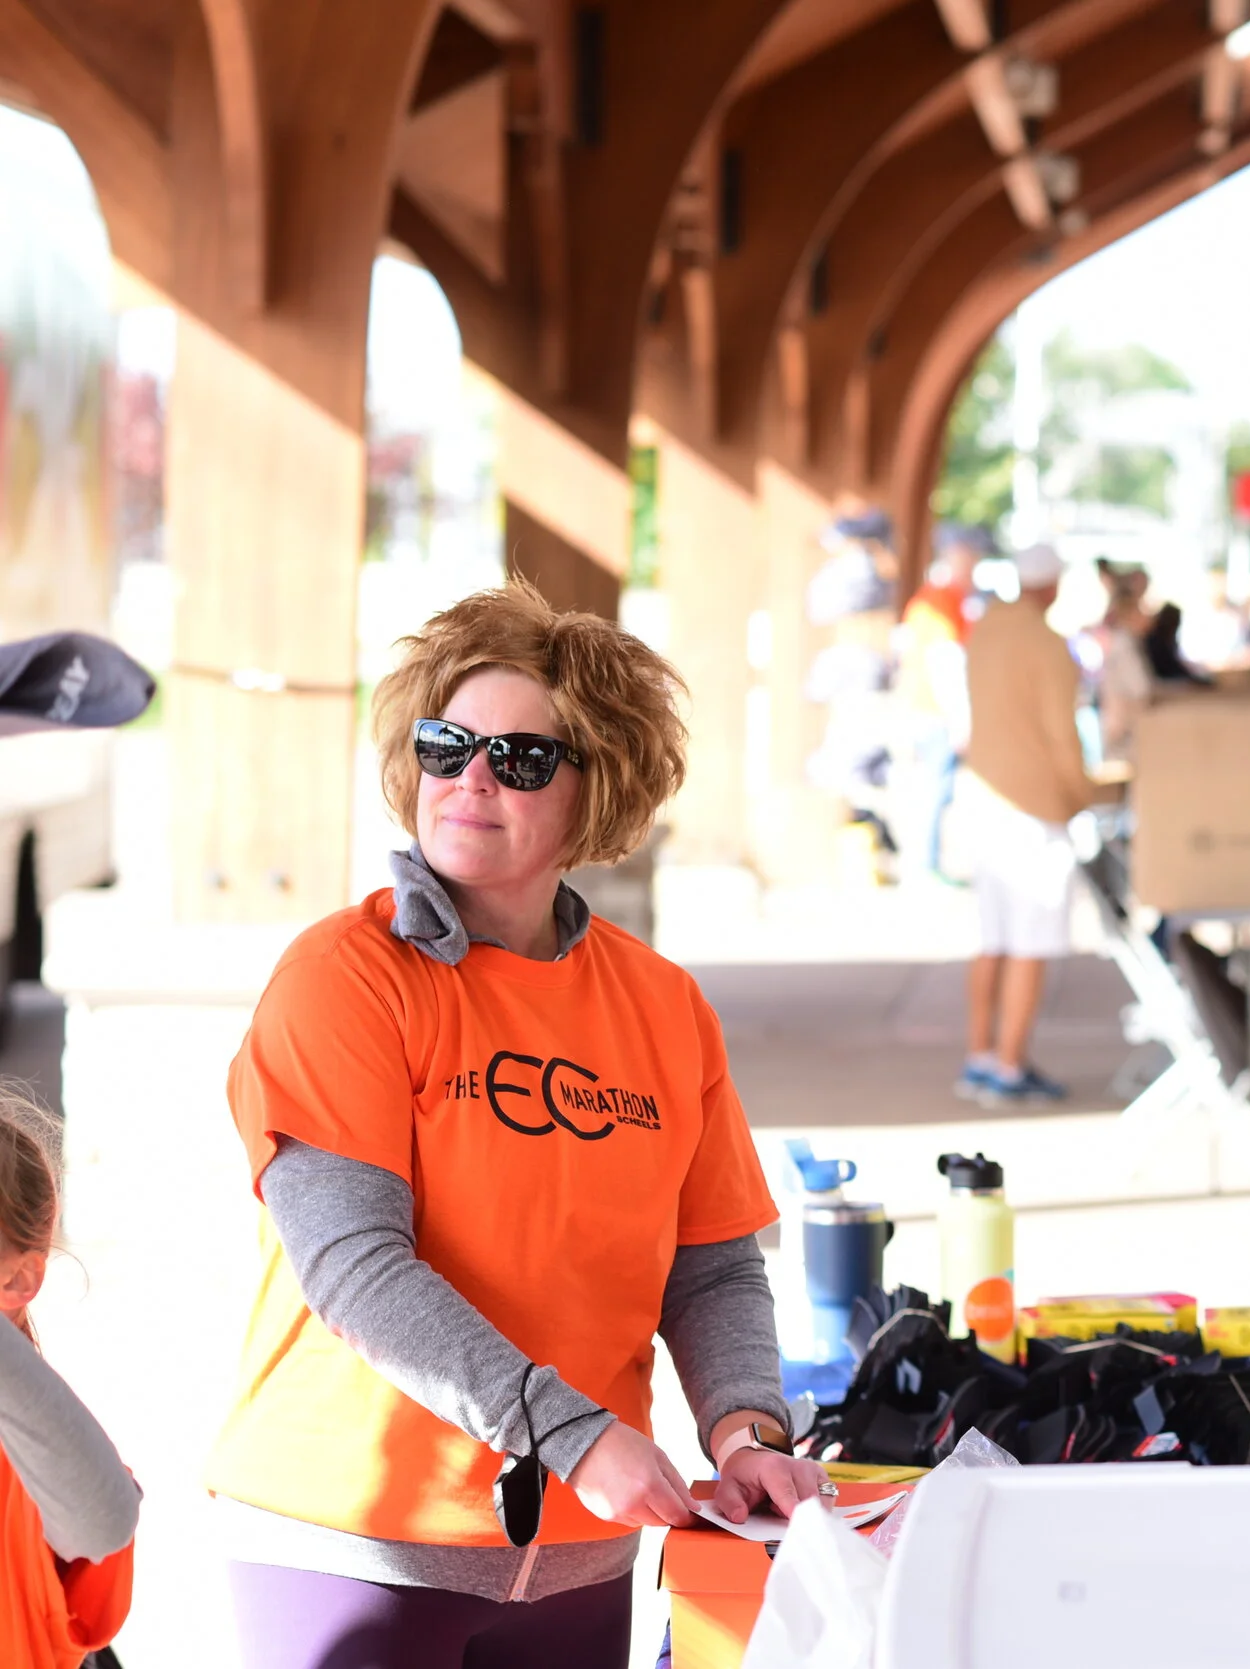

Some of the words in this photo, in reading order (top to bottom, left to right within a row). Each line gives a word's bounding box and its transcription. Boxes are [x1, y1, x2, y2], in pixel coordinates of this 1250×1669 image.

[445, 1071, 480, 1100] THE
[485, 1050, 615, 1141] EC
[559, 1080, 660, 1121] MARATHON
[616, 1115, 662, 1130] SCHEELS
